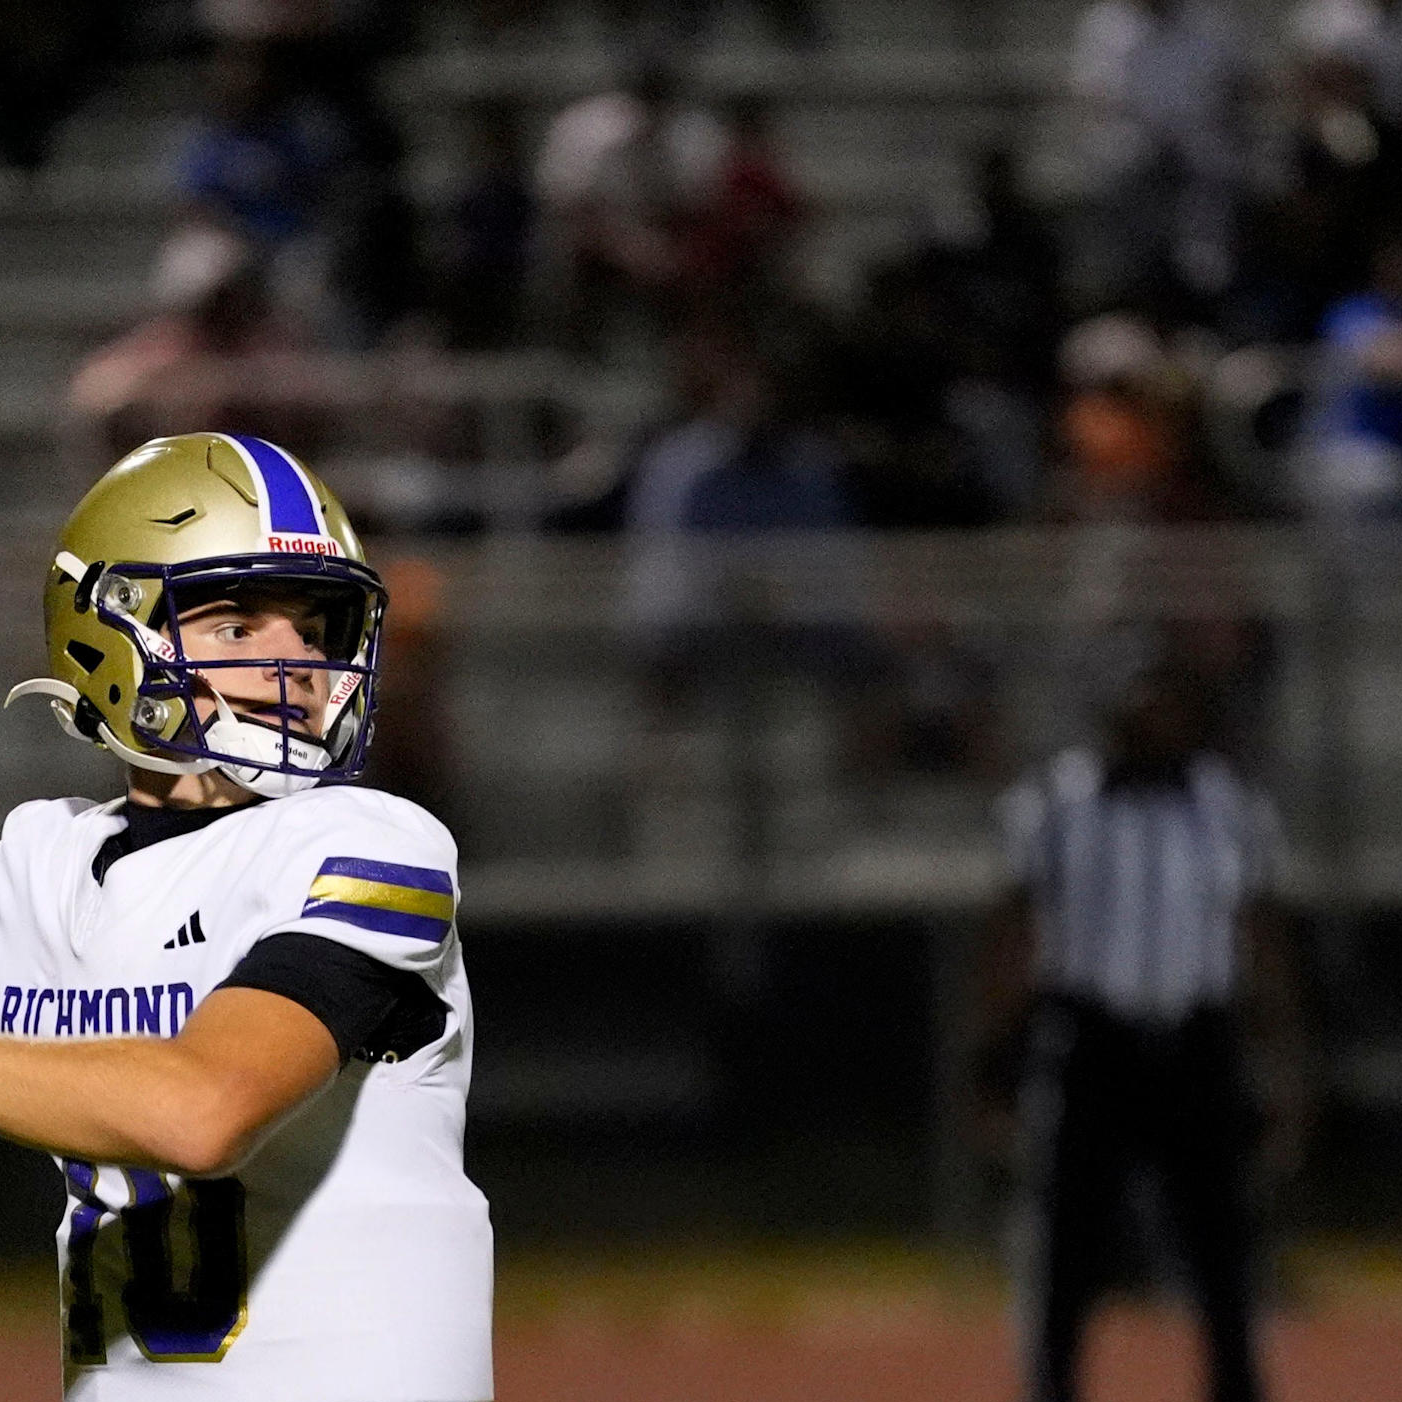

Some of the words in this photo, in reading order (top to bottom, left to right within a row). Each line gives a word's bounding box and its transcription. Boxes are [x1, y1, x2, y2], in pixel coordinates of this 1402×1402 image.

[268, 537, 338, 556] Riddell
[275, 742, 309, 760] Rddell
[0, 982, 194, 1039] RICHMOND
[64, 1160, 249, 1366] 10
